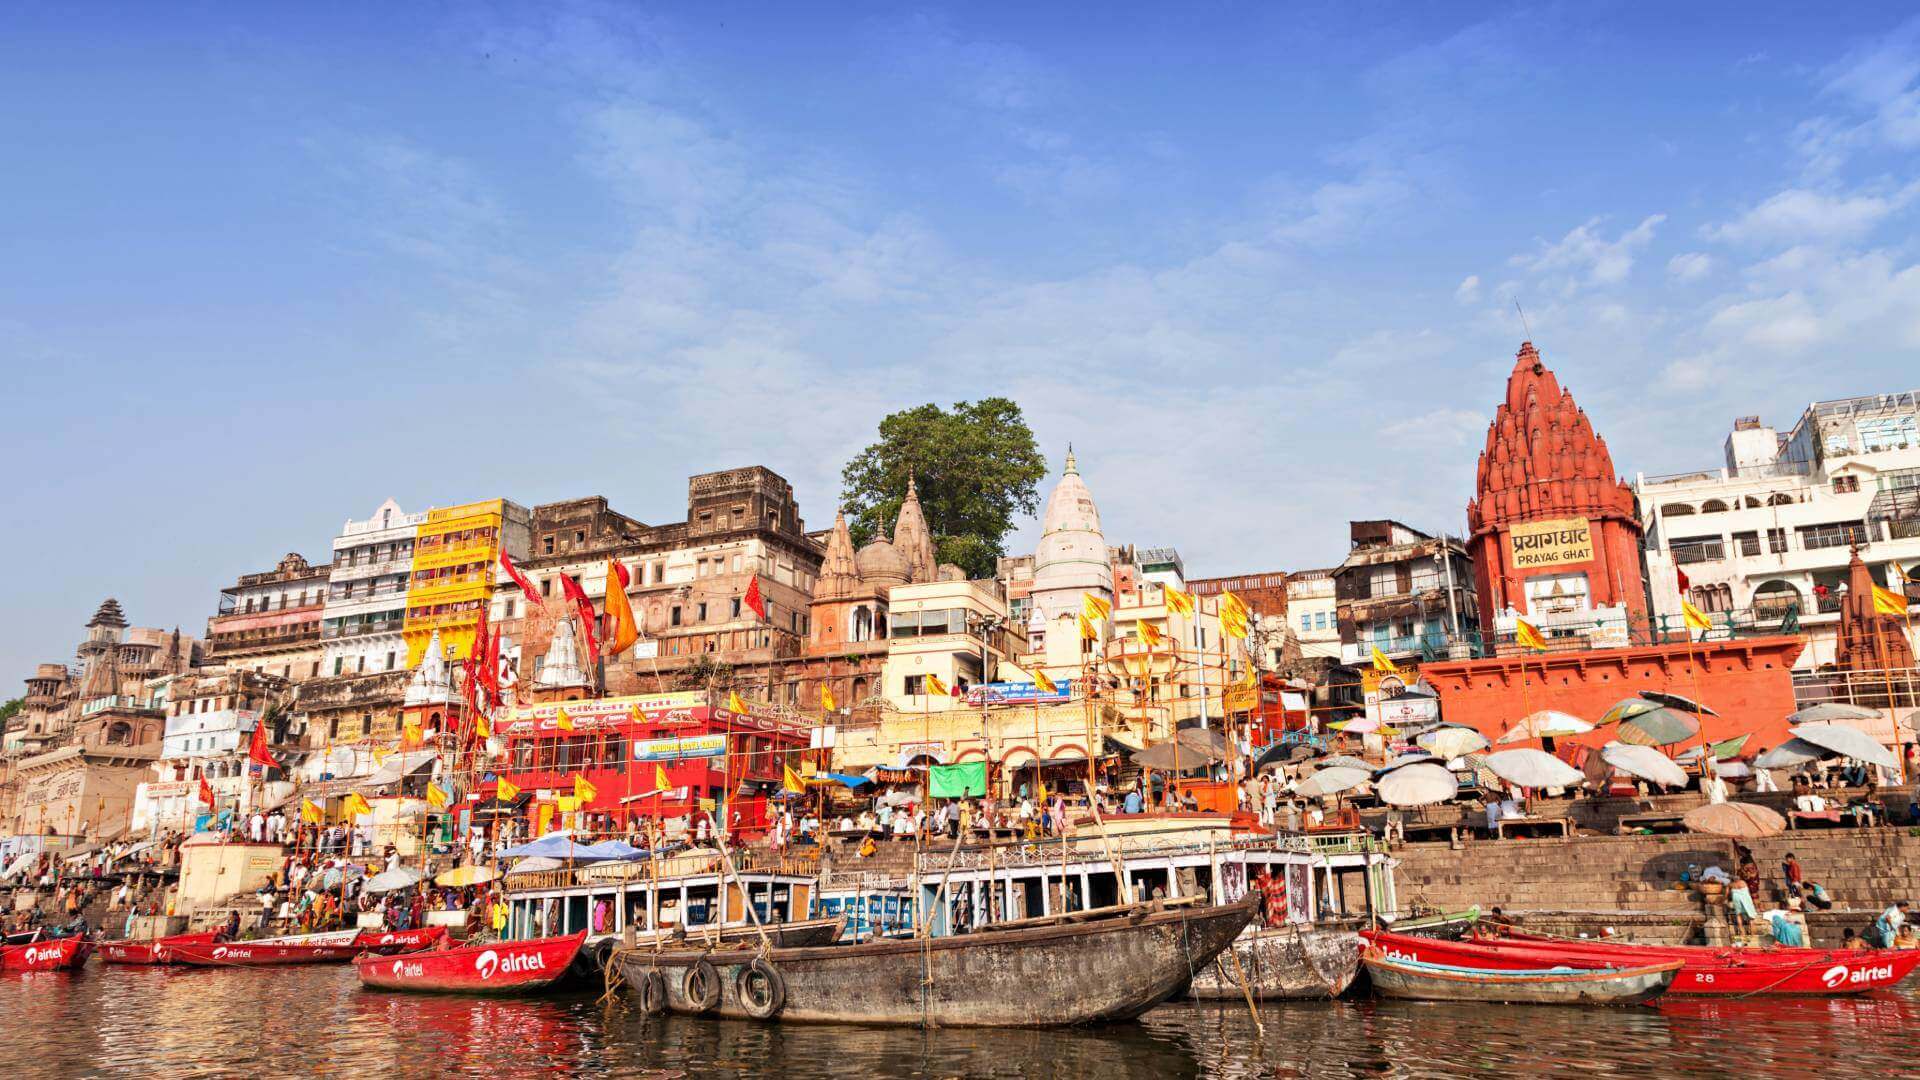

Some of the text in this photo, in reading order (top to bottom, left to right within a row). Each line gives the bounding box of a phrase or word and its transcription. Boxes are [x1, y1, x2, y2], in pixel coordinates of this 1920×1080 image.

[1512, 528, 1589, 553] प्रयाग घाट
[1518, 548, 1591, 565] PRAYAG GHAT
[321, 936, 351, 946] Finance
[38, 948, 62, 961] airtel
[227, 949, 251, 958] airtel
[404, 962, 423, 977] airtel
[501, 952, 545, 972] airtel
[1695, 973, 1715, 983] 28
[1850, 964, 1893, 983] airtel
